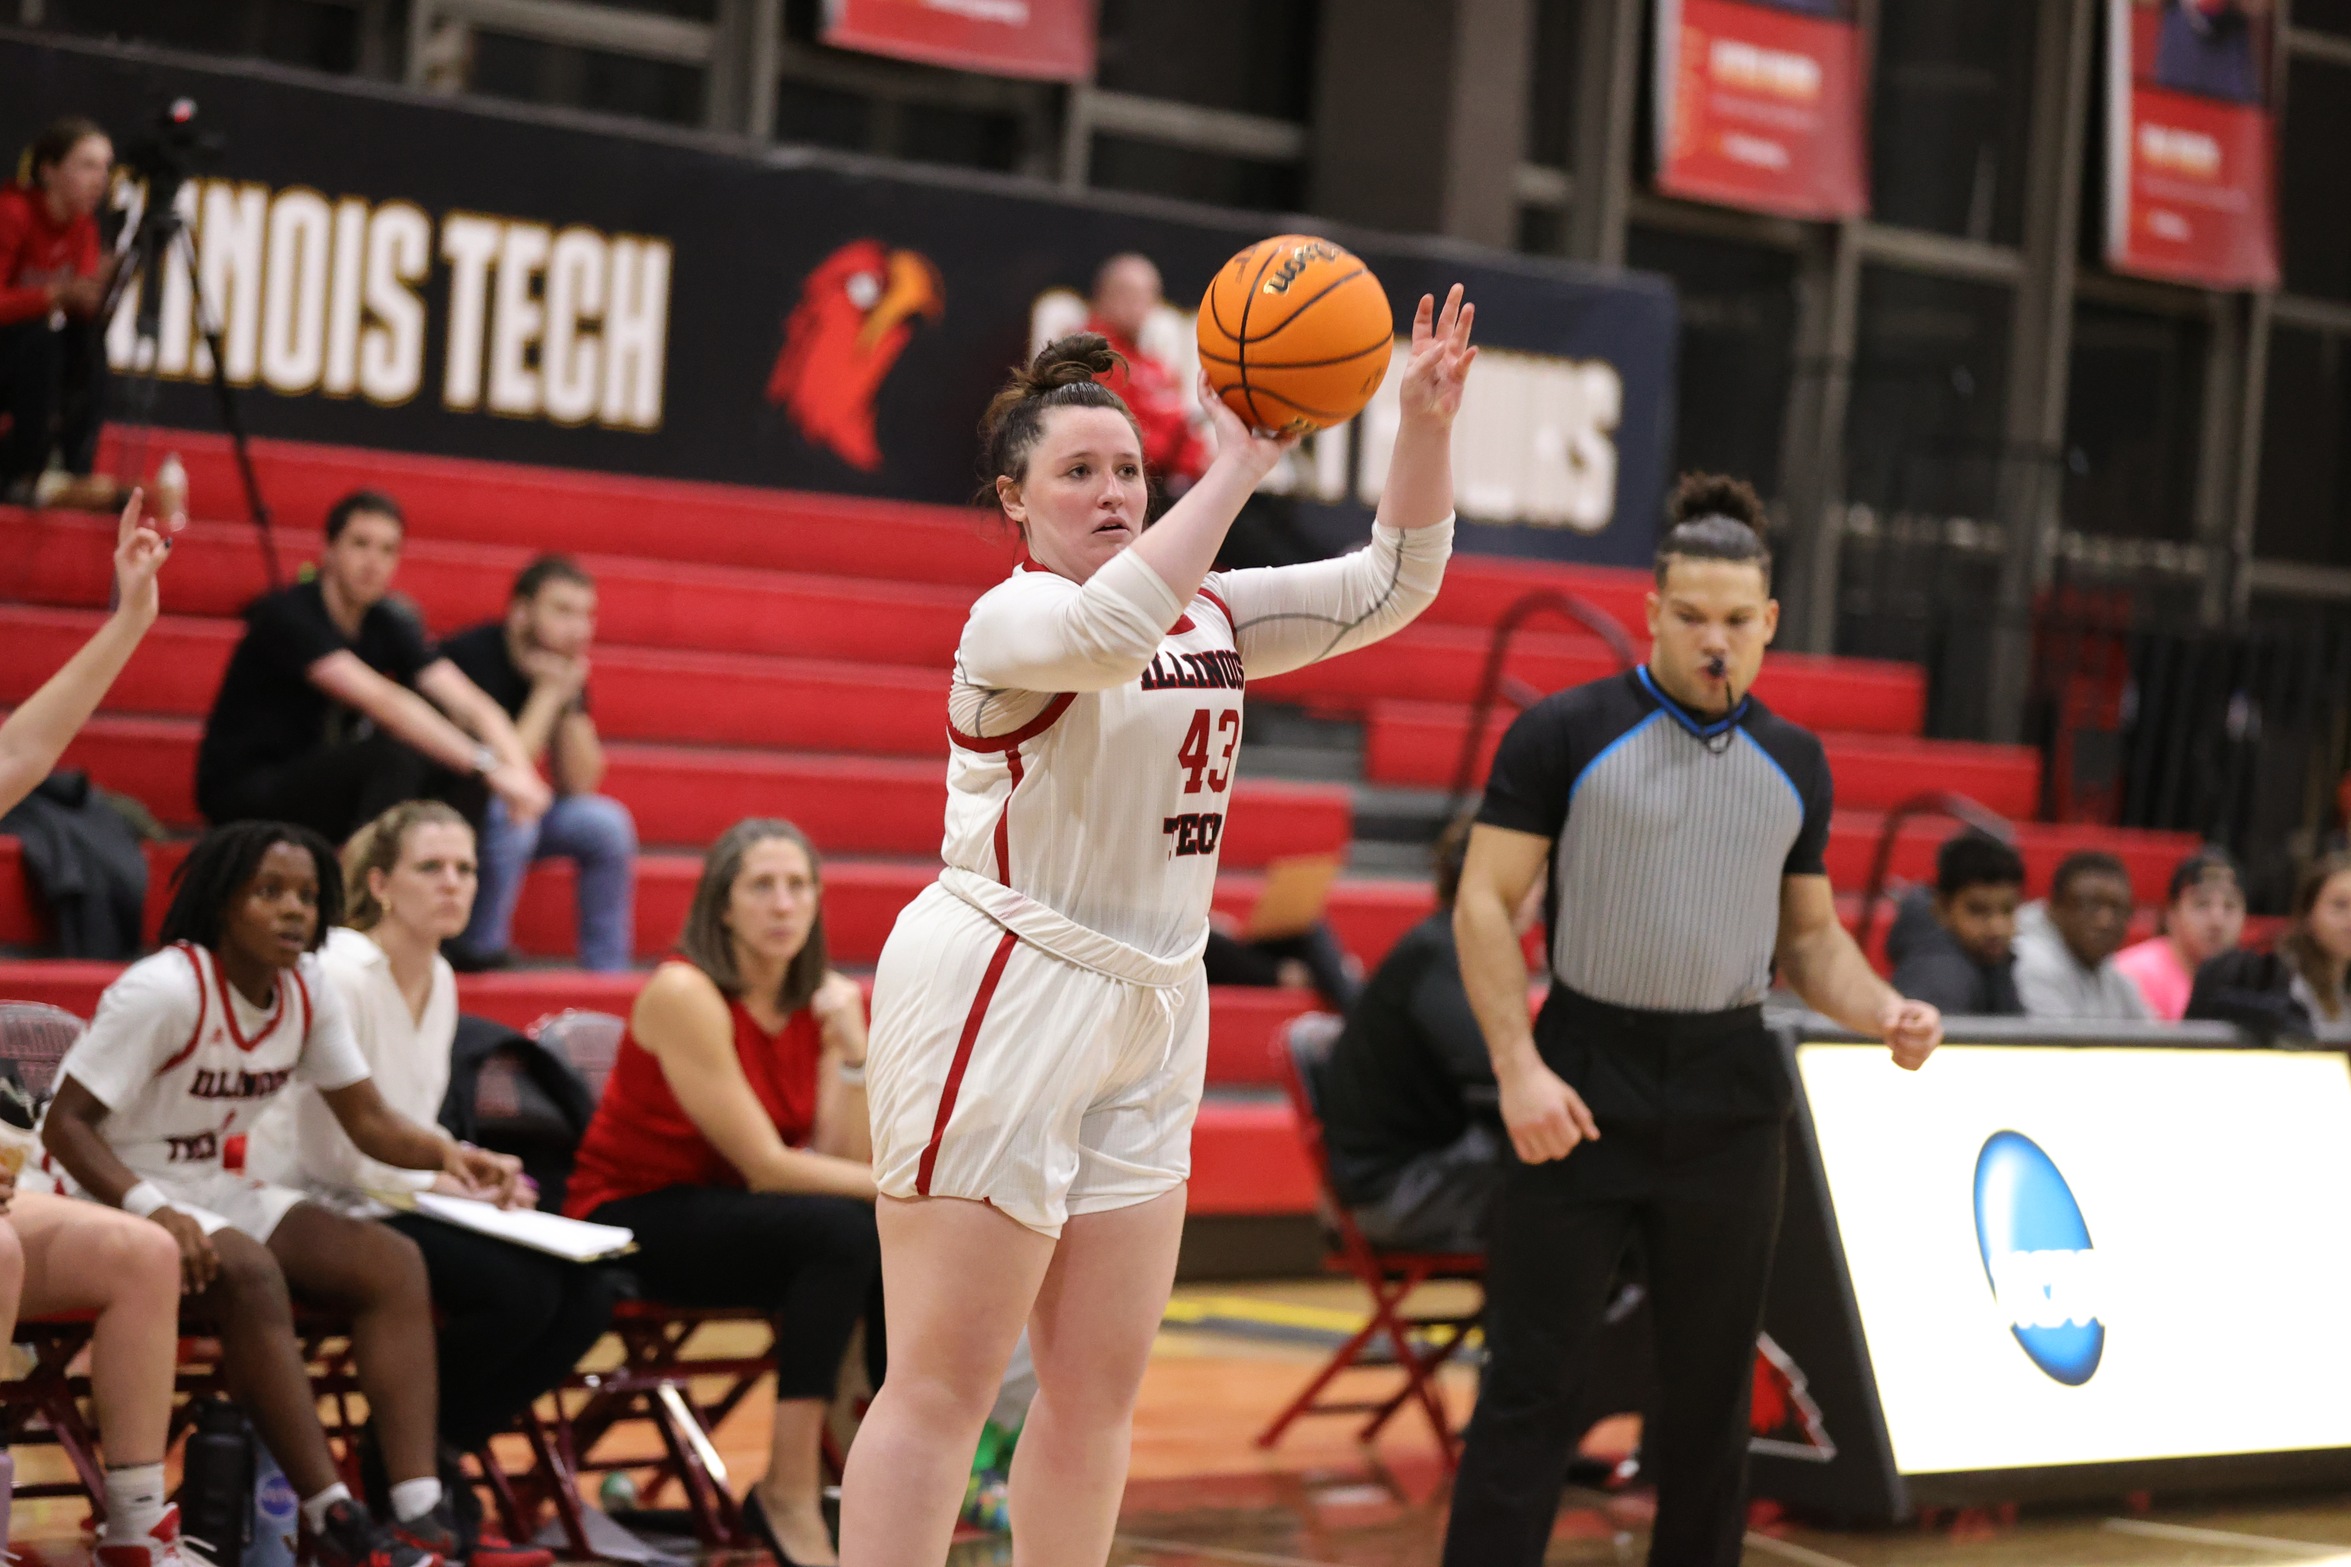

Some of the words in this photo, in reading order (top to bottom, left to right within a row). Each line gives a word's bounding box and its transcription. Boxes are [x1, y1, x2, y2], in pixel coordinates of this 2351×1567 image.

[102, 164, 433, 407] LINOIS
[440, 209, 673, 432] TECH
[1178, 708, 1240, 794] 43
